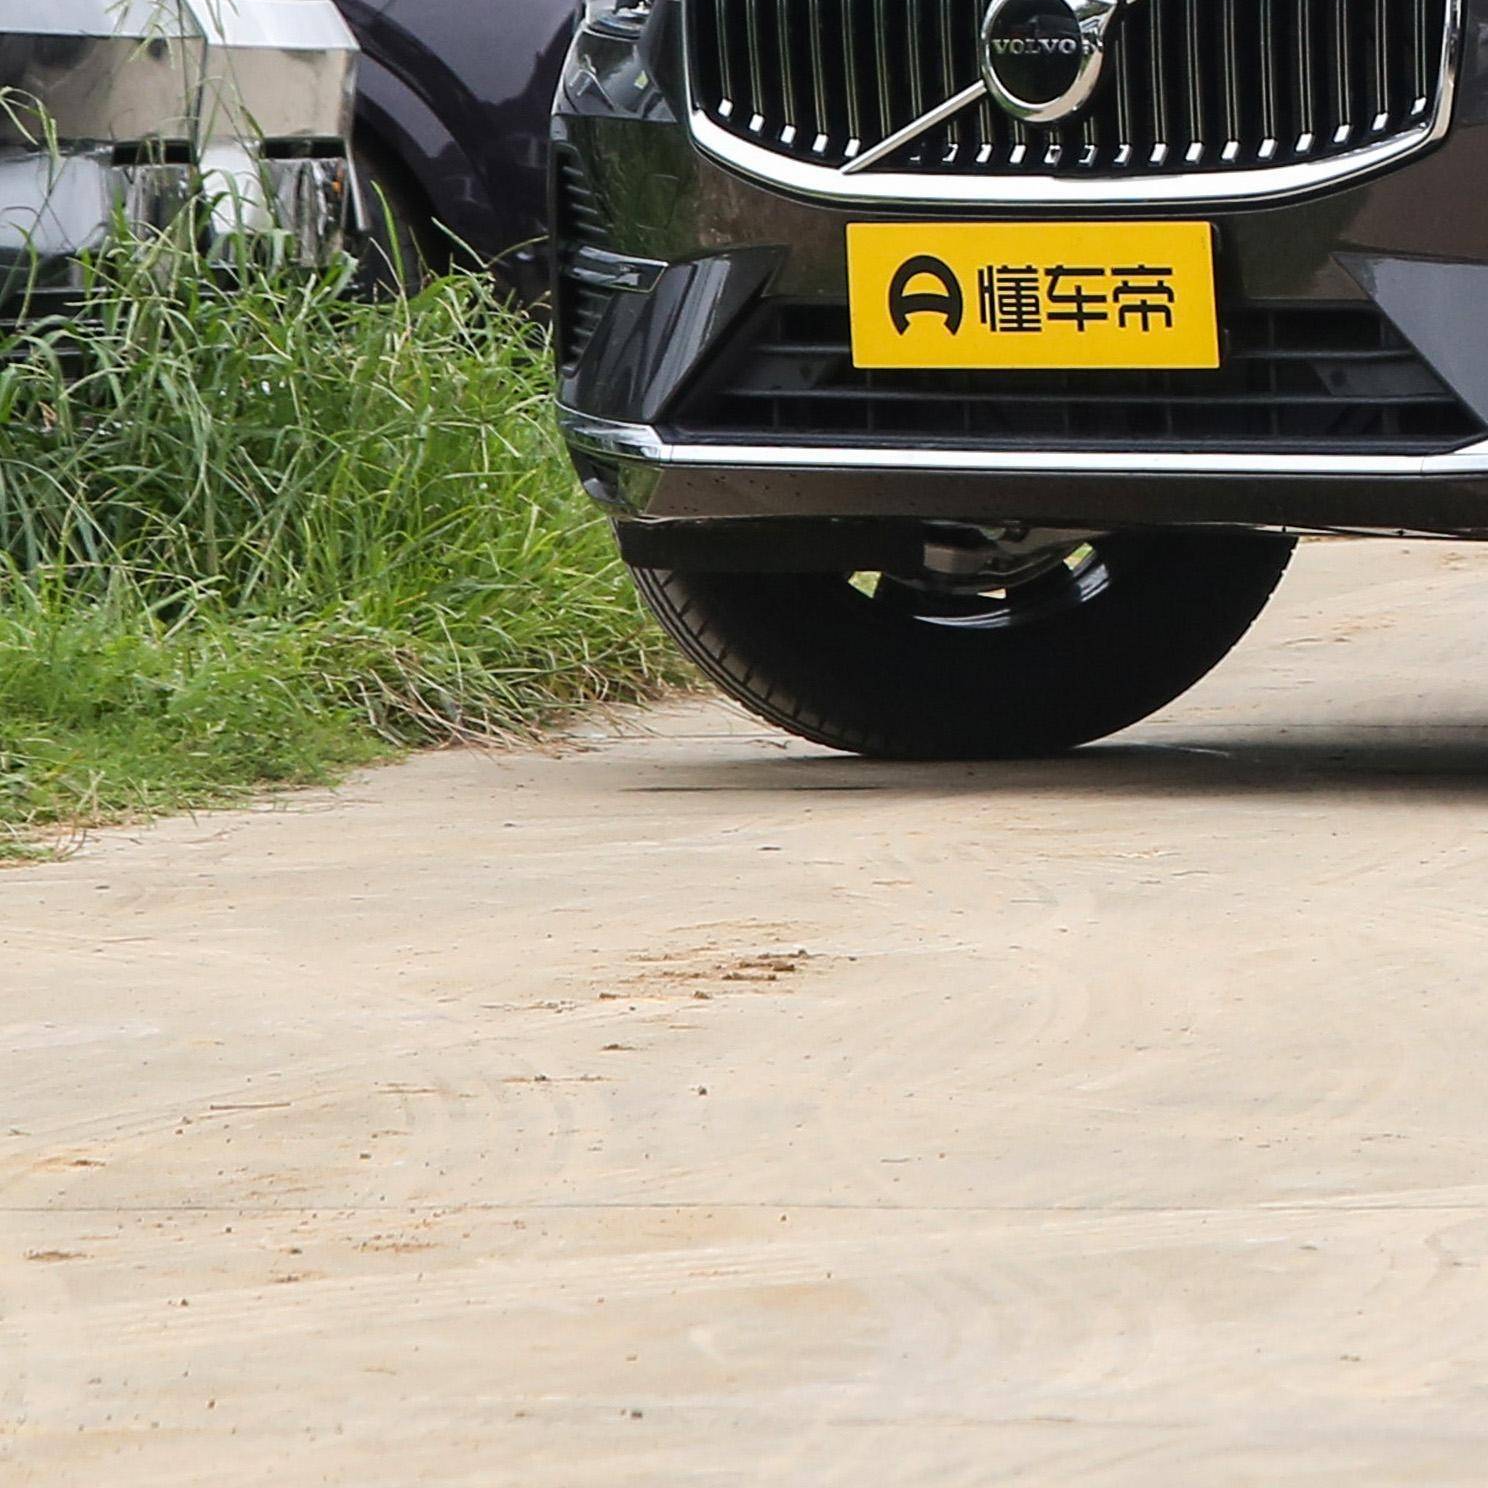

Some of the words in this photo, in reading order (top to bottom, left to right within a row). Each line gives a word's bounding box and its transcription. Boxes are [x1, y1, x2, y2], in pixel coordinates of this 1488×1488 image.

[991, 37, 1077, 55] VOLVO
[977, 263, 1176, 333] 懂车帝
